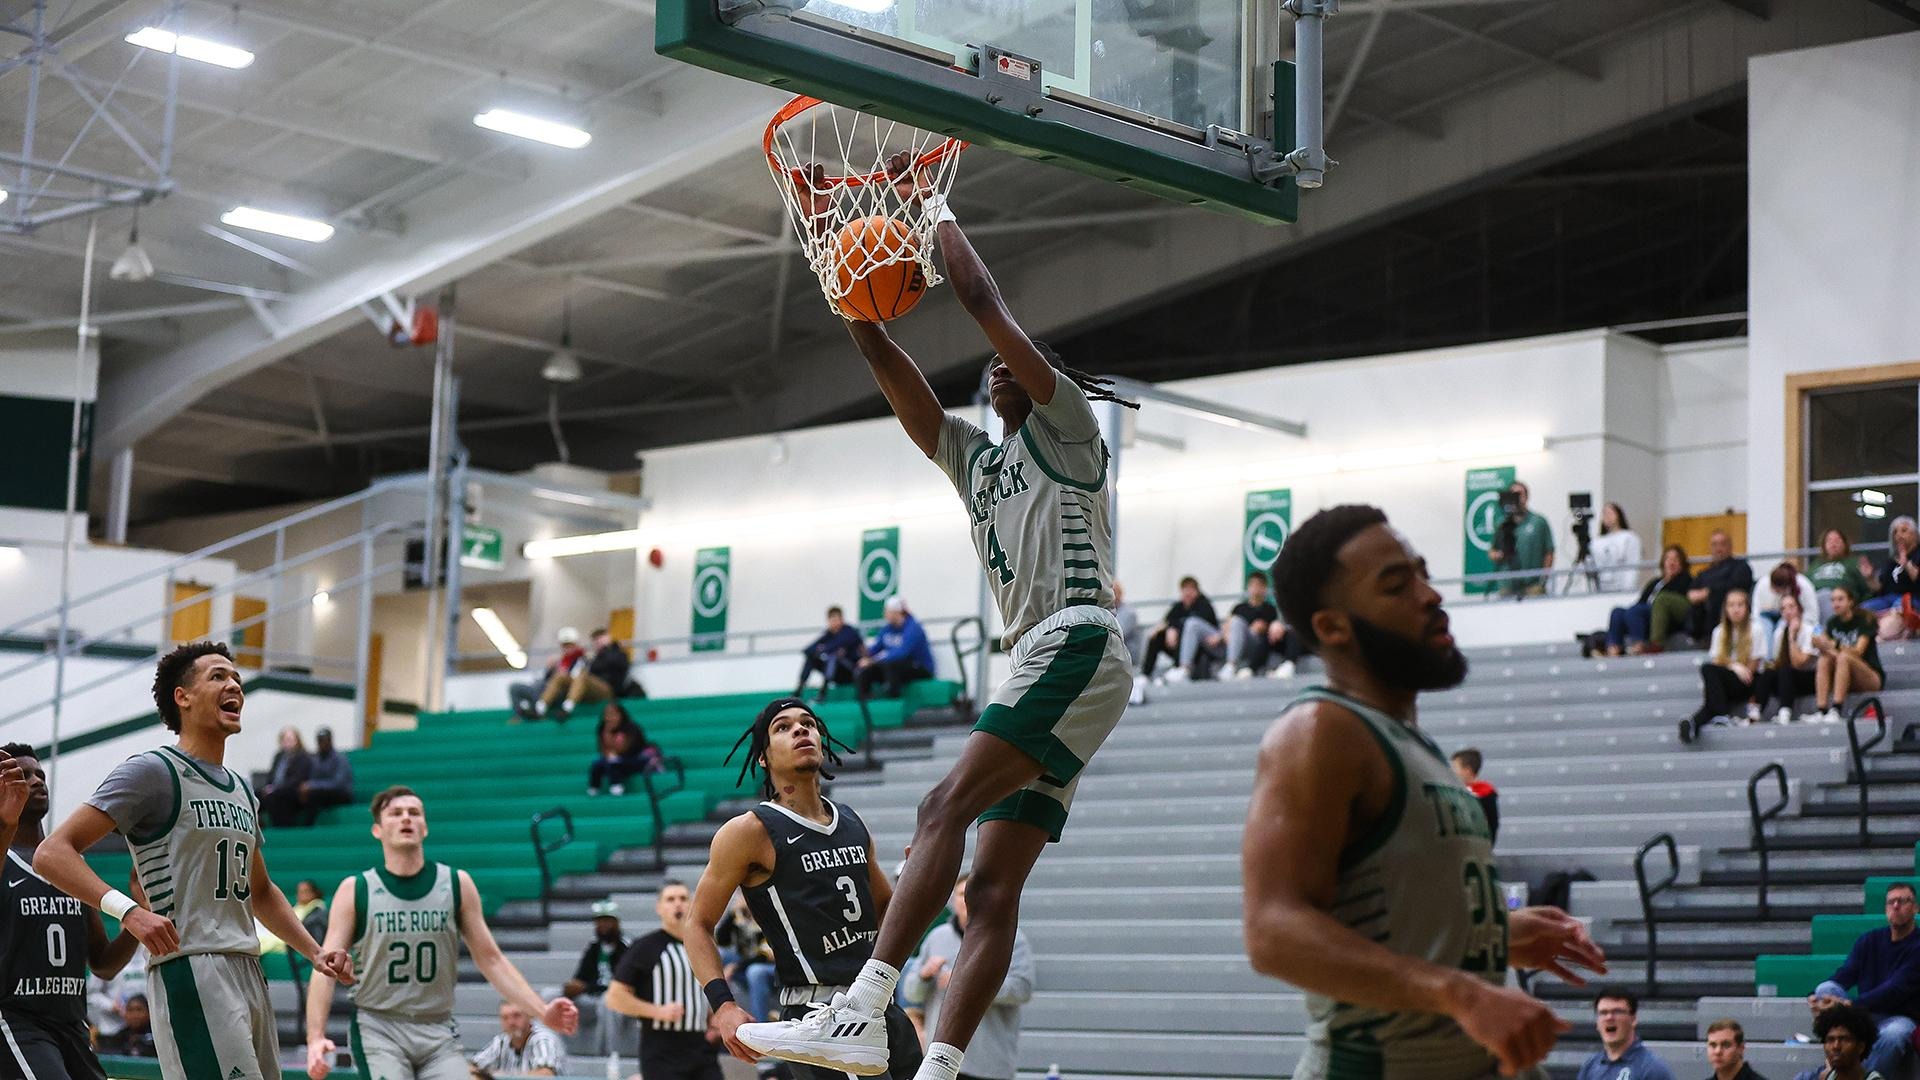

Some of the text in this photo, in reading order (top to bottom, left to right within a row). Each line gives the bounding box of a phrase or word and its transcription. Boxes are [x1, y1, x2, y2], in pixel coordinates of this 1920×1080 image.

[986, 522, 1016, 588] 4
[189, 799, 231, 829] THE
[213, 837, 252, 903] 13
[800, 845, 868, 873] GREATER
[20, 896, 82, 916] GREATER
[835, 875, 862, 922] 3
[374, 909, 449, 933] THE ROCK
[46, 923, 67, 967] 0
[387, 940, 438, 985] 20
